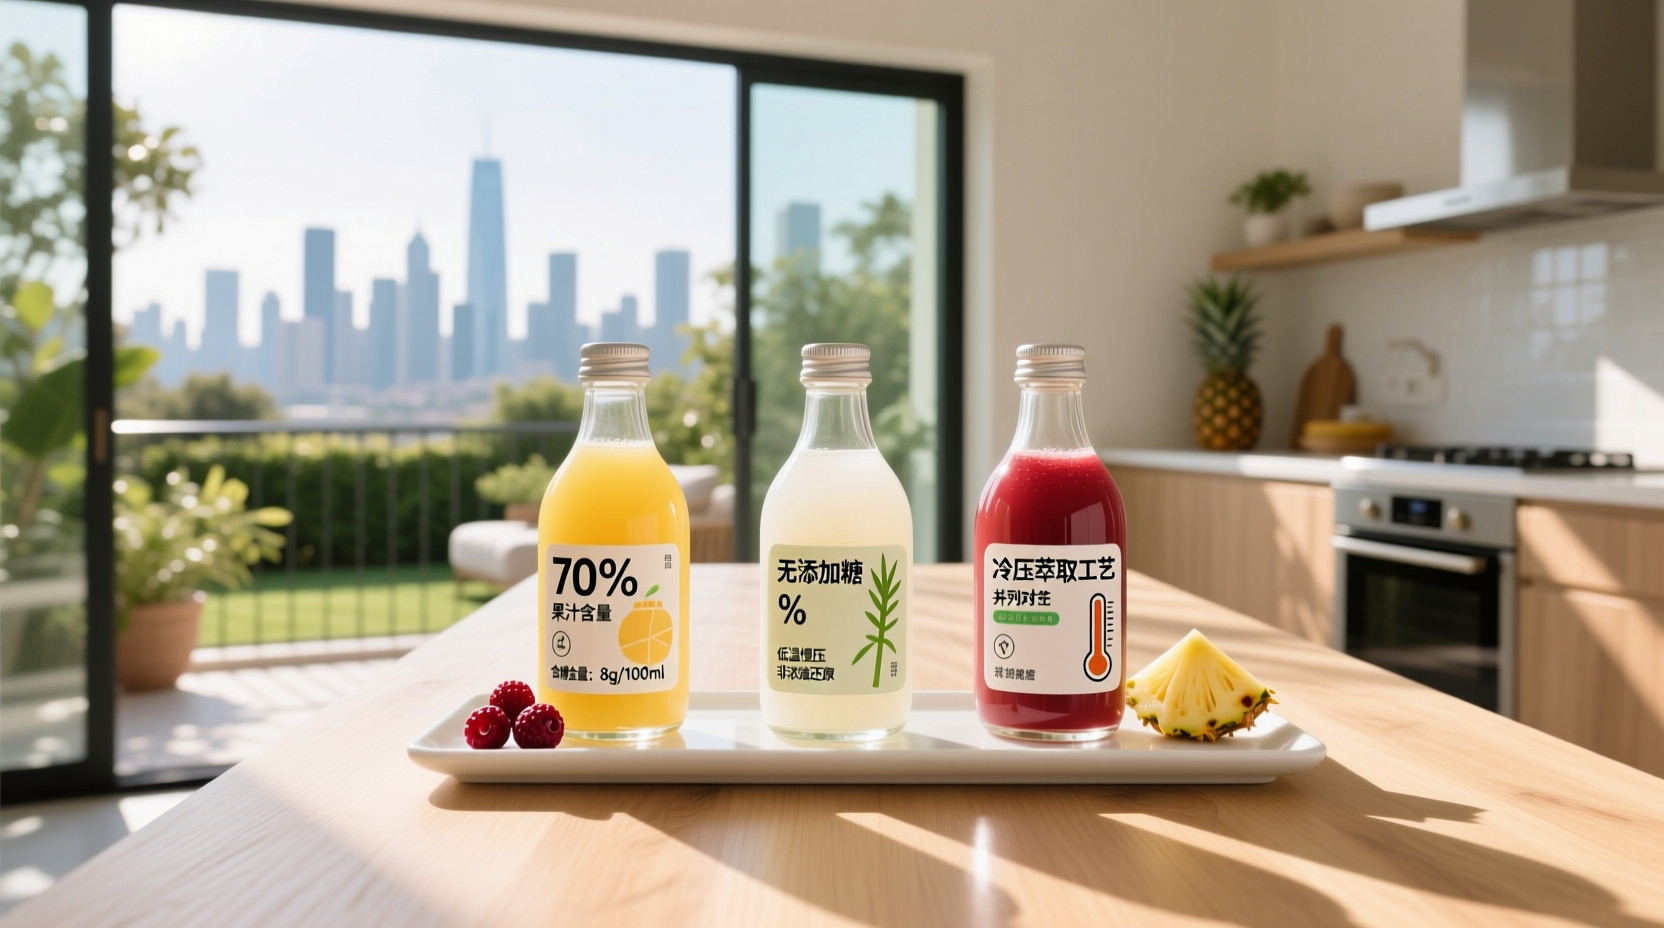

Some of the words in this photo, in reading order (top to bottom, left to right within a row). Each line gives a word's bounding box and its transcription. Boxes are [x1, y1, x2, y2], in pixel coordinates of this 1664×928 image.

[552, 557, 638, 597] 70%
[777, 558, 863, 585] 无添加糖
[992, 556, 1116, 583] 冷压萃取工艺
[551, 602, 612, 622] 果汁含量
[778, 594, 807, 625] %
[600, 664, 665, 685] 8g/100ml
